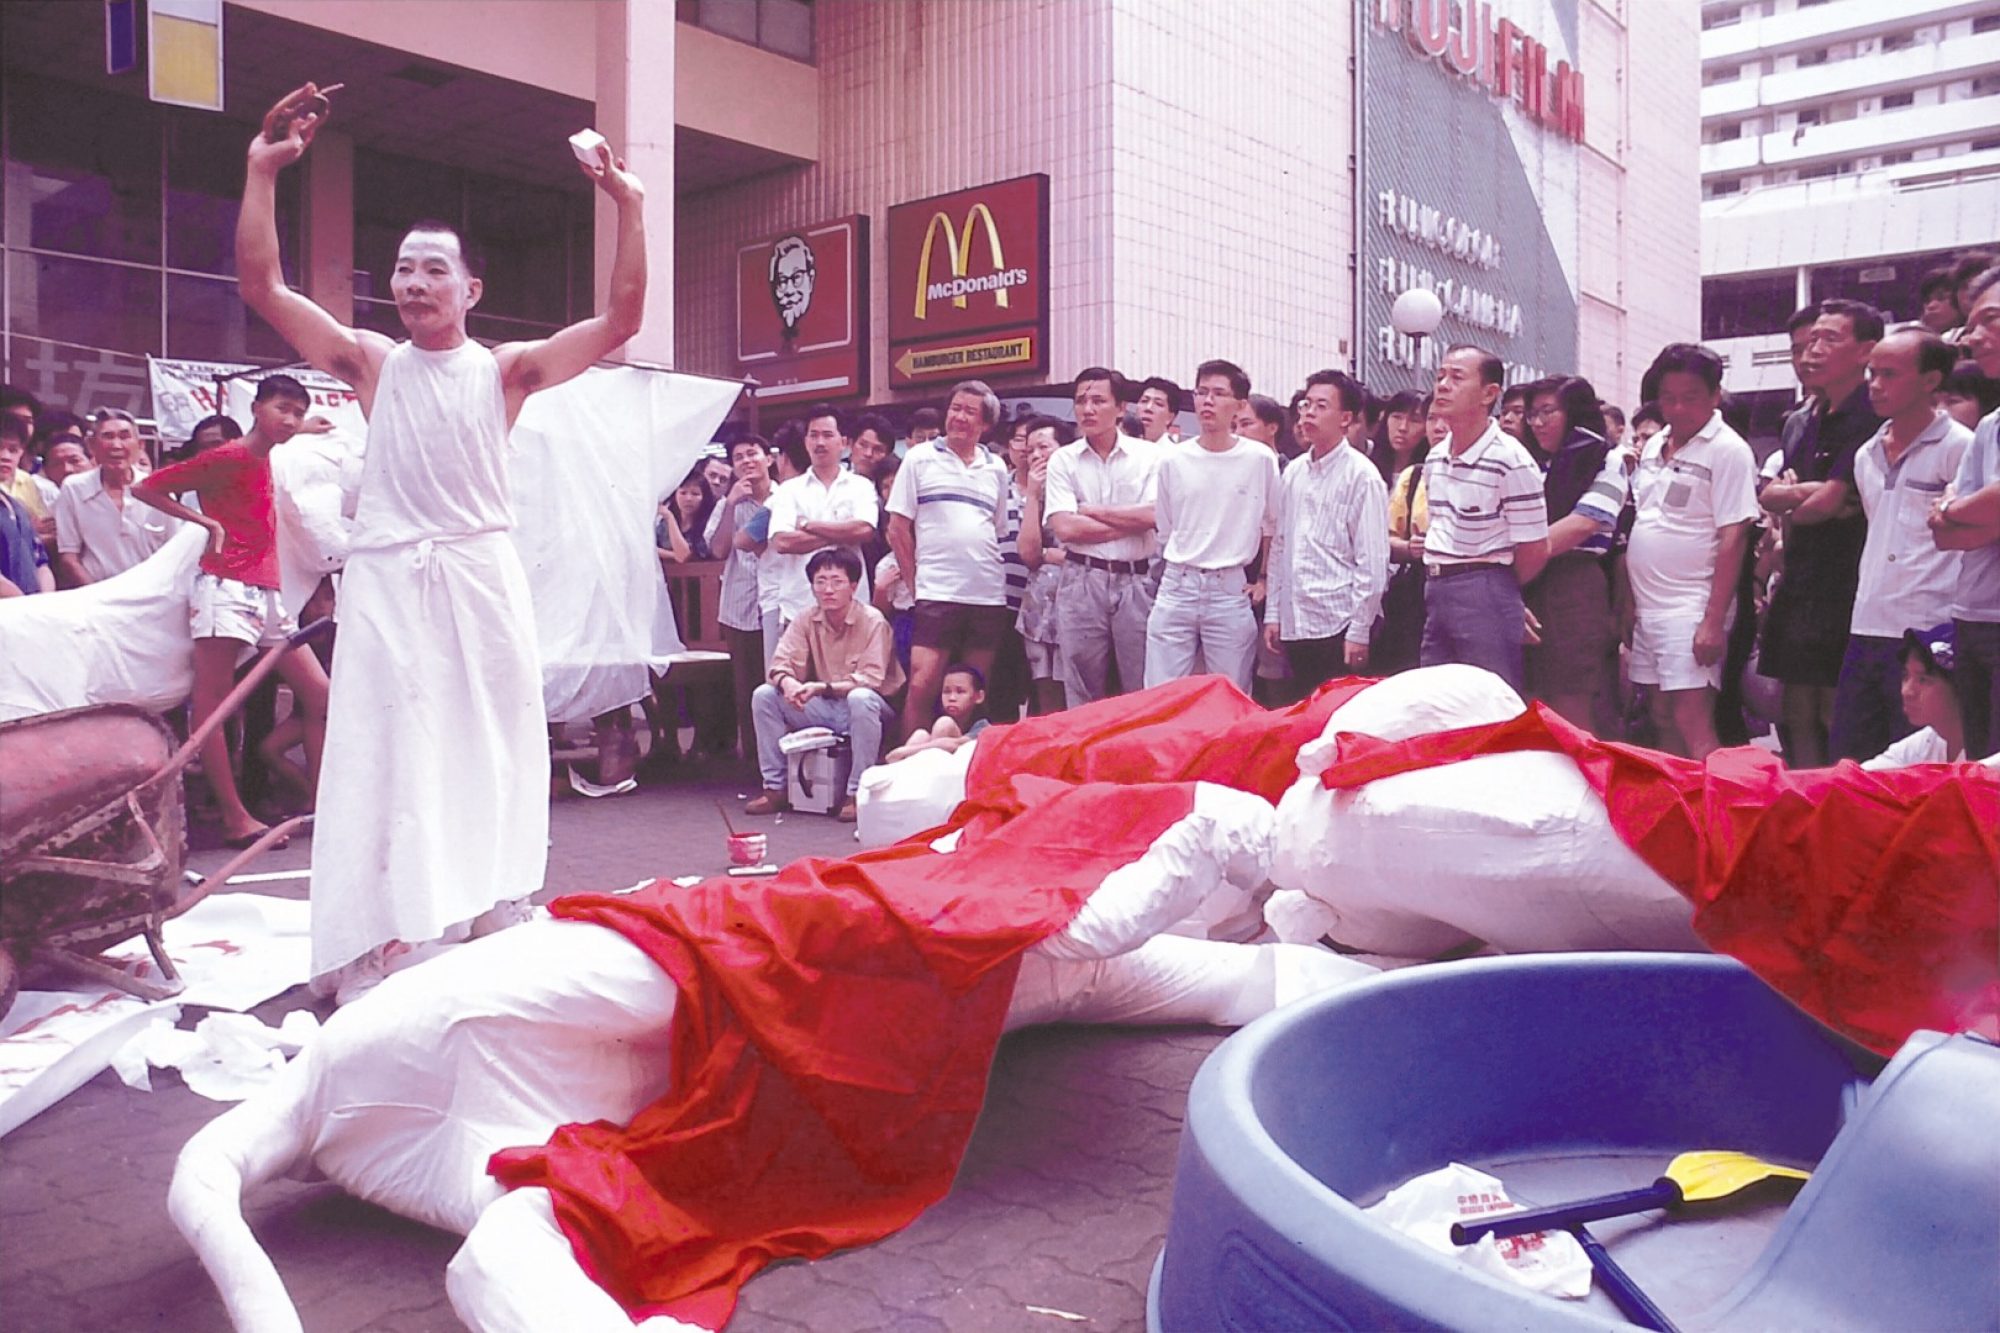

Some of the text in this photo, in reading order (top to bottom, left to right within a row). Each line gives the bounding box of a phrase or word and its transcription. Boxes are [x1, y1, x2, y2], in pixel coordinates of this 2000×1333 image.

[927, 268, 1028, 301] McDonald's
[913, 343, 1022, 369] HAMBURGER RESTAURANT
